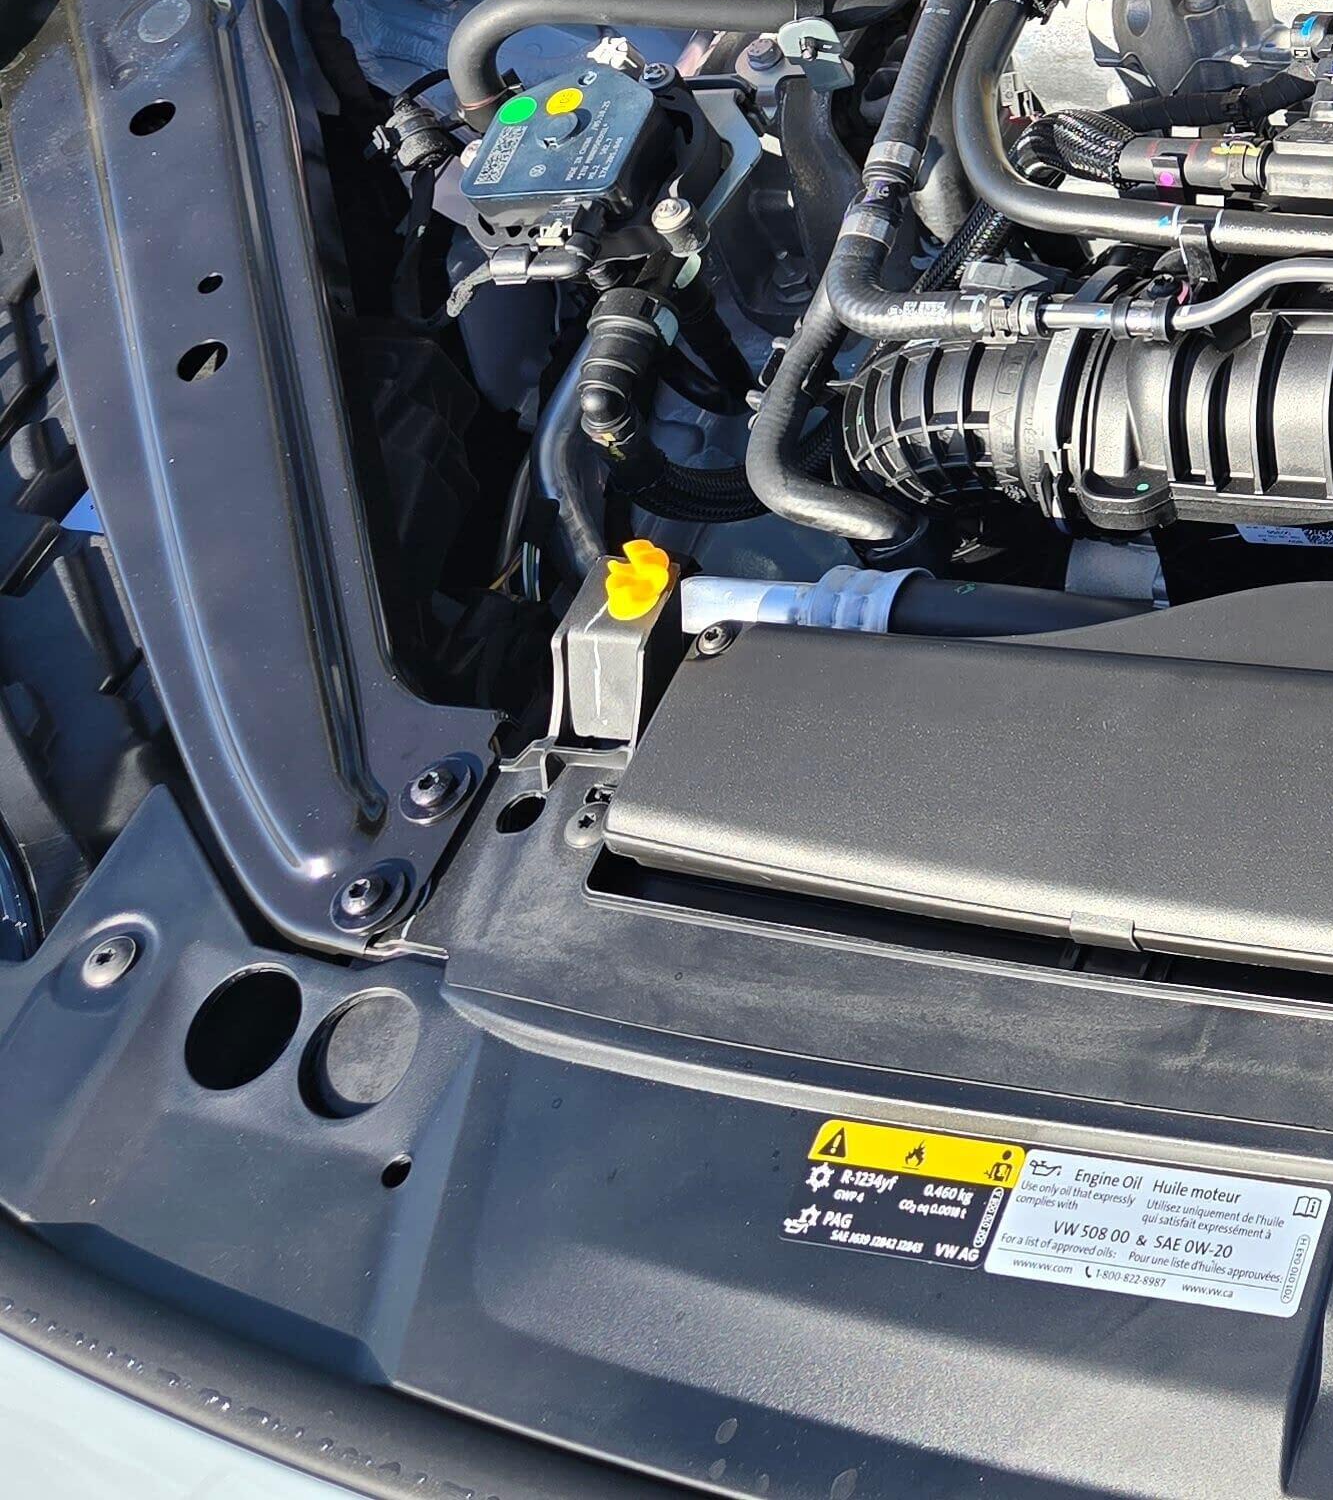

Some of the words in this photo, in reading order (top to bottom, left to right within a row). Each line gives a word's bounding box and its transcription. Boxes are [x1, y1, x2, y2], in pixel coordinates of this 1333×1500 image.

[840, 1168, 899, 1194] R-1234yf
[1020, 1180, 1038, 1192] Use
[1038, 1184, 1060, 1197] only
[1060, 1185, 1072, 1197] oil
[1072, 1186, 1092, 1200] that
[1092, 1191, 1136, 1208] expressly
[1075, 1168, 1120, 1188] Engine
[1122, 1176, 1144, 1190] Oil
[1152, 1179, 1190, 1197] Huile
[1190, 1189, 1242, 1204] moteur
[834, 1189, 856, 1202] GWP
[924, 1184, 957, 1200] 0.460
[956, 1188, 974, 1206] kg
[1016, 1194, 1056, 1208] complies
[1057, 1198, 1078, 1211] with
[822, 1210, 854, 1229] PAG
[917, 1204, 928, 1216] eq
[1146, 1200, 1182, 1215] Utilisez
[1182, 1206, 1240, 1222] uniquement
[1241, 1212, 1254, 1224] de
[830, 1230, 848, 1242] SAE
[1141, 1212, 1160, 1226] qui
[1158, 1215, 1197, 1230] satisfait
[1197, 1221, 1264, 1240] expressément
[1264, 1230, 1272, 1240] à
[934, 1242, 960, 1259] VW
[958, 1244, 980, 1262] AG
[1001, 1232, 1017, 1244] For
[1024, 1236, 1040, 1248] list
[1040, 1239, 1052, 1250] of
[1052, 1240, 1095, 1256] approved
[1096, 1246, 1117, 1259] oils:
[1053, 1220, 1080, 1236] VW
[1080, 1225, 1108, 1241] 508
[1110, 1229, 1130, 1244] 00
[1135, 1234, 1148, 1247] &
[1153, 1236, 1183, 1252] SAE
[1184, 1239, 1234, 1259] 0W-20
[1012, 1258, 1074, 1274] www.vw.com
[1096, 1268, 1167, 1288] 1-800-822-8987
[1182, 1282, 1234, 1298] www.vw.ca
[1128, 1250, 1151, 1264] Pour
[1151, 1256, 1170, 1267] une
[1170, 1256, 1190, 1270] liste
[1226, 1267, 1283, 1284] approuvées:
[1282, 1284, 1294, 1300] 701
[1288, 1267, 1300, 1283] 010
